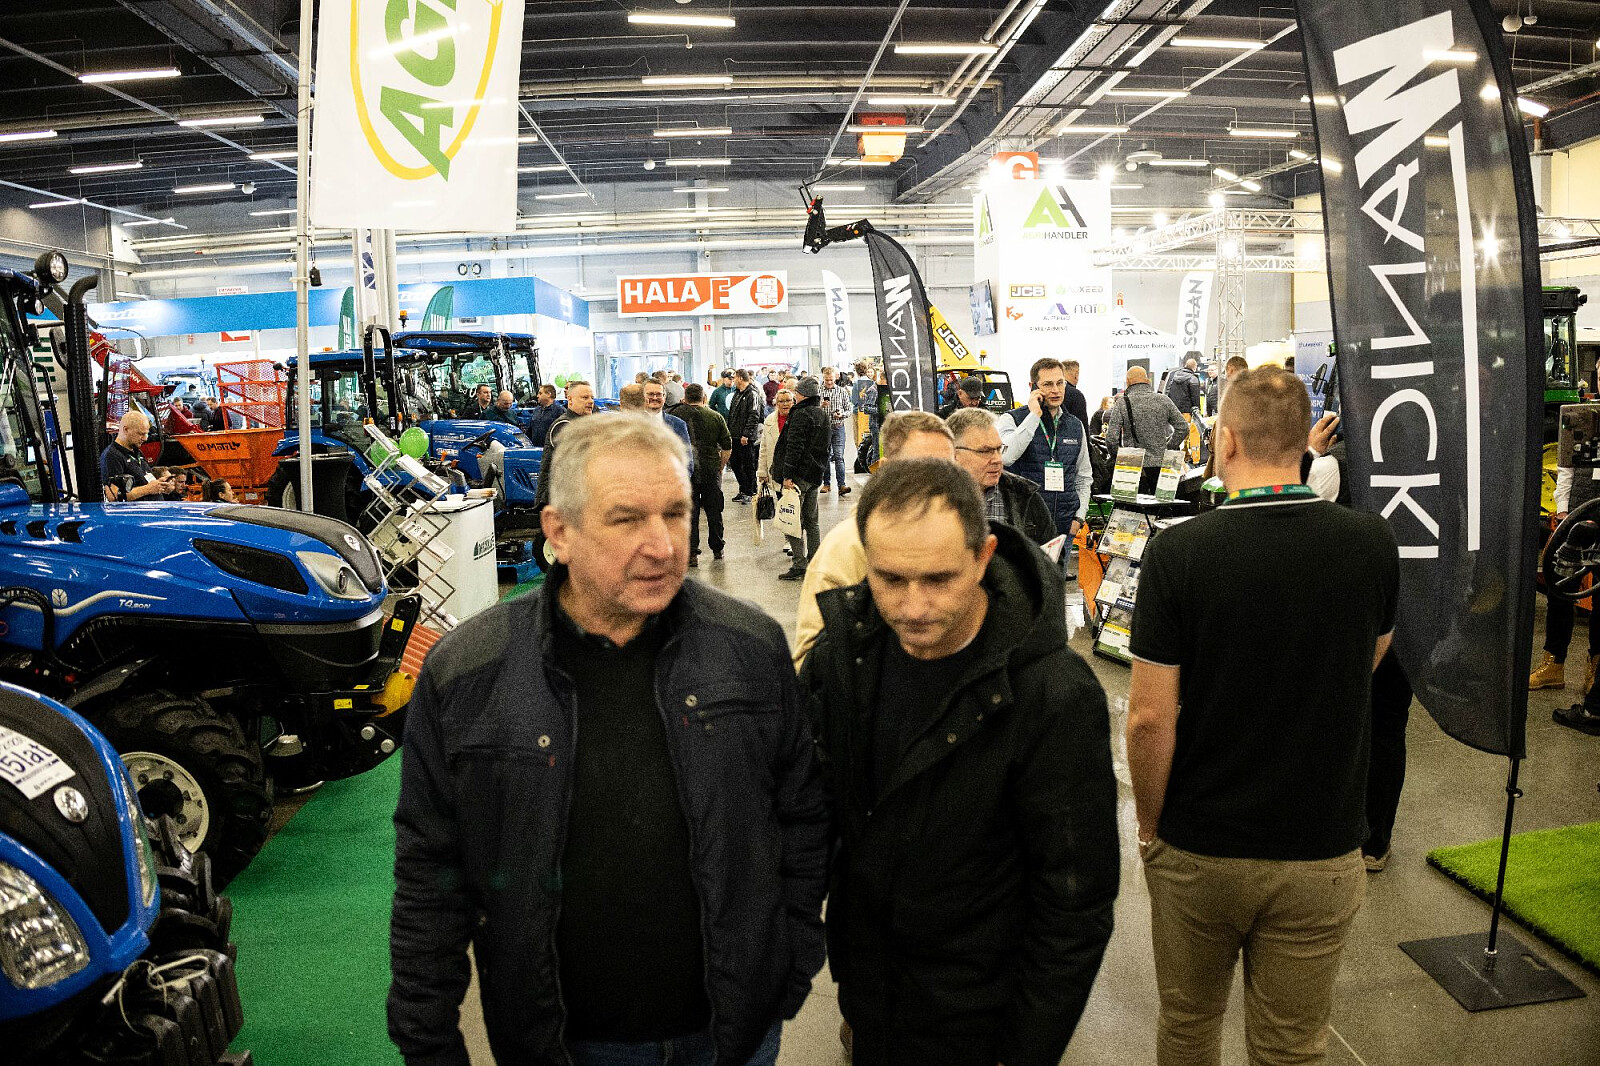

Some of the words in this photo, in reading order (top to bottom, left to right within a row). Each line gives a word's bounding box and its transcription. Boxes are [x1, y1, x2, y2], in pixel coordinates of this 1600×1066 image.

[1005, 155, 1034, 179] G
[624, 281, 701, 304] HALA
[711, 279, 730, 309] E
[1010, 286, 1045, 297] JCB
[1183, 279, 1204, 346] SOLAN
[936, 324, 968, 360] JCB
